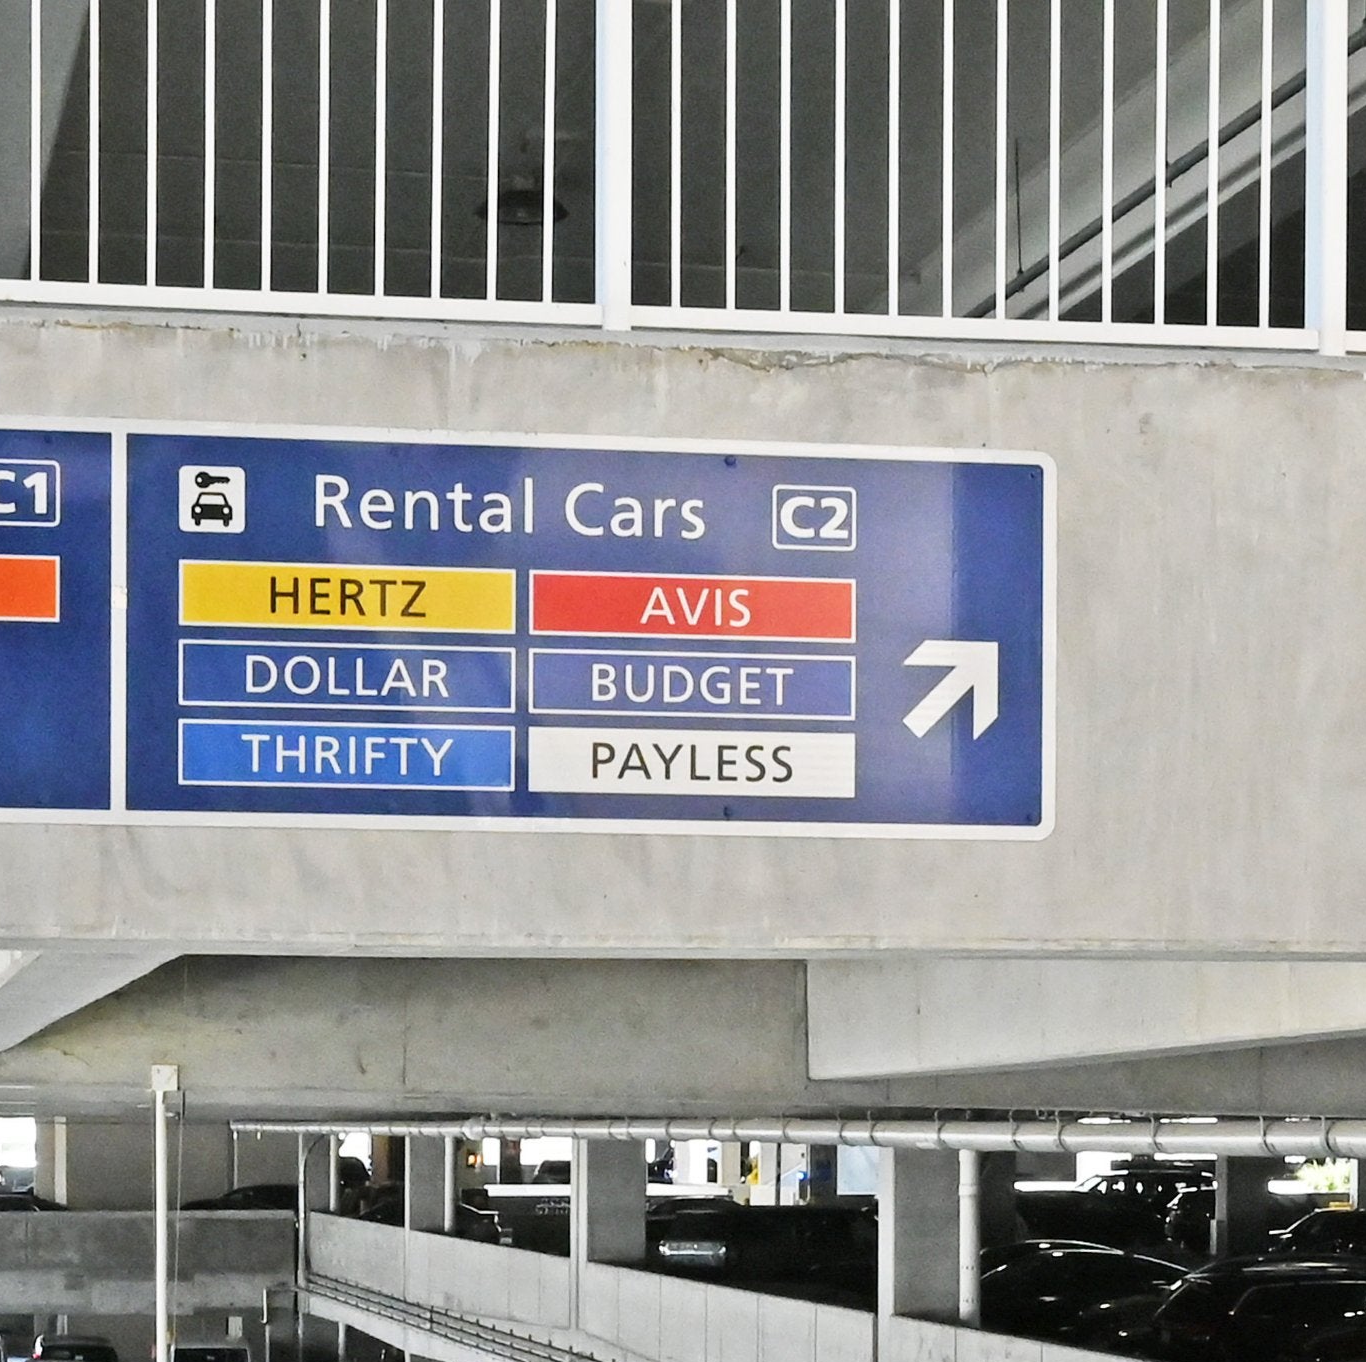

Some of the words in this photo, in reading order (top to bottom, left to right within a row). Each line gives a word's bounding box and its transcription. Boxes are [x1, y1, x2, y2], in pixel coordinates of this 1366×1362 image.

[315, 474, 533, 535] Rental
[564, 482, 705, 541] Cars
[778, 495, 851, 540] C2
[269, 576, 427, 619] HERTZ
[640, 588, 751, 629] AVIS
[244, 654, 450, 699] DOLLAR
[591, 665, 794, 708] BUDGET
[242, 734, 454, 779] THRIFTY
[591, 742, 794, 785] PAYLESS
